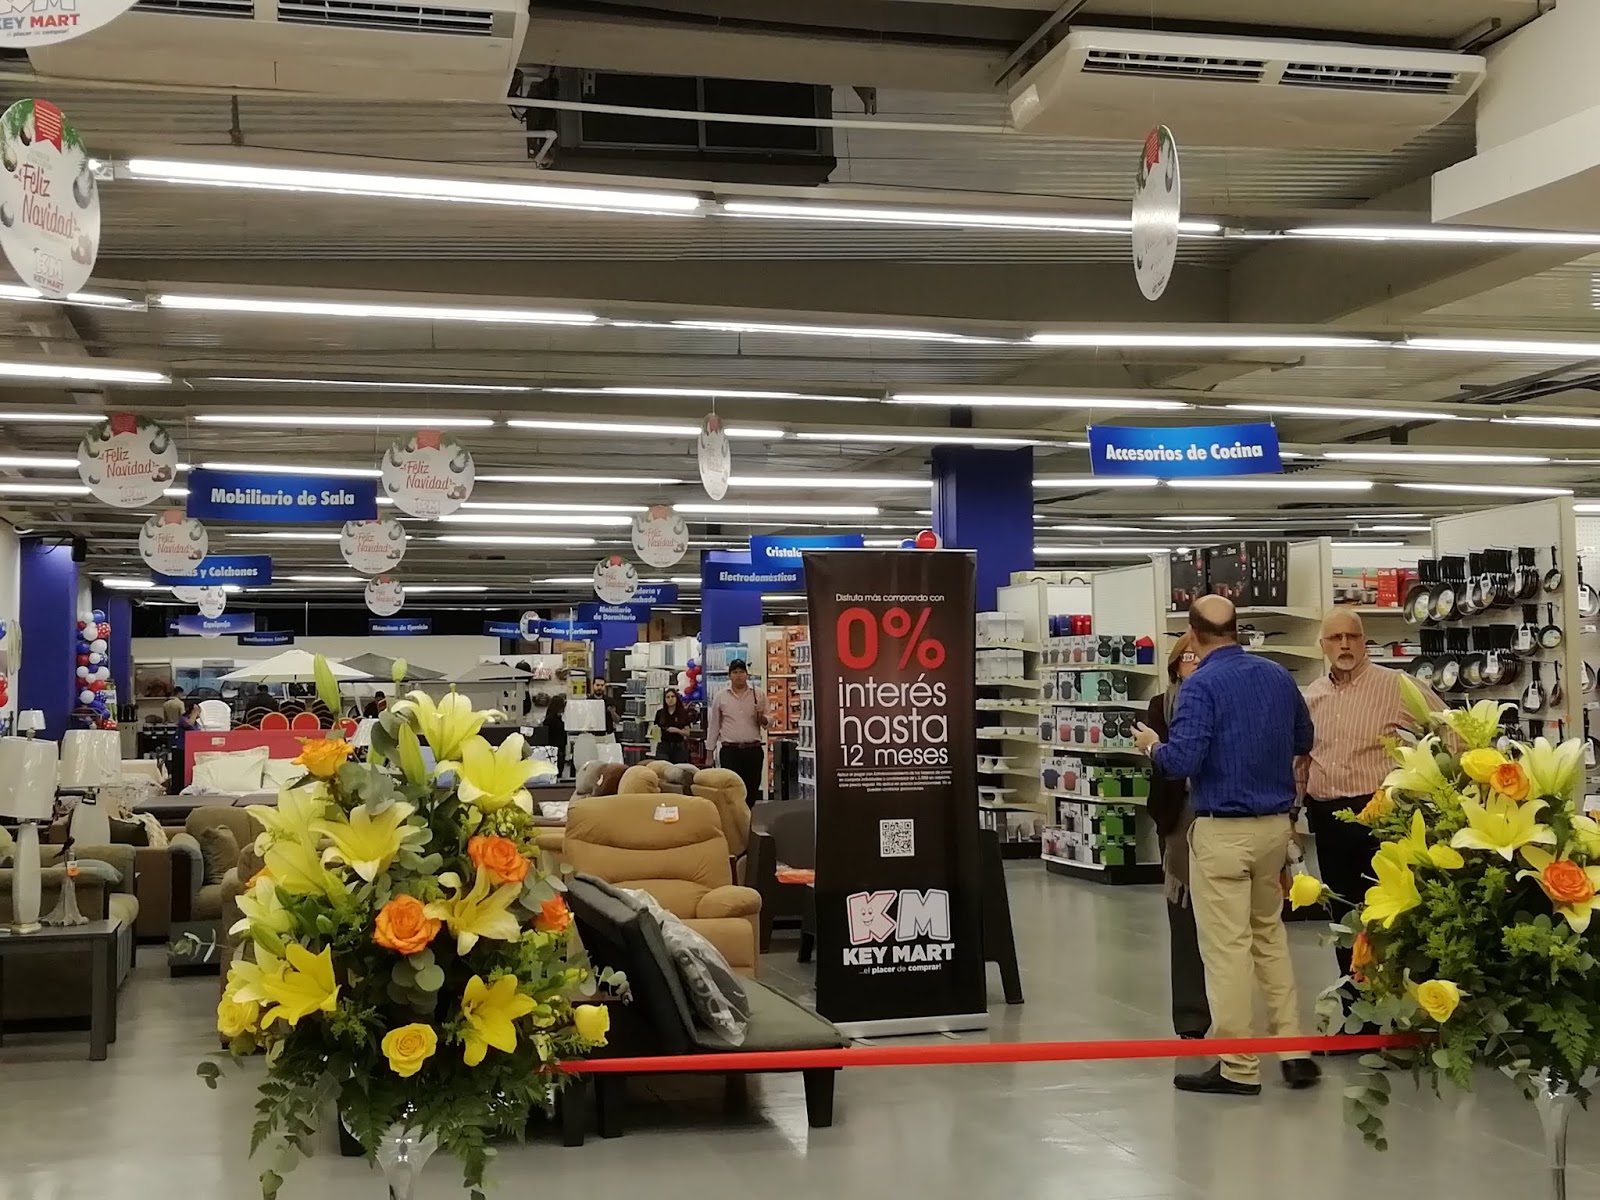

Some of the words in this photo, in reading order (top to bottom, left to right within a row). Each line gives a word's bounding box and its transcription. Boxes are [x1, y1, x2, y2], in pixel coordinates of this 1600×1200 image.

[30, 14, 80, 28] MART
[23, 163, 50, 197] Feliz
[22, 194, 73, 239] Navidad
[47, 279, 64, 290] MART
[105, 447, 129, 462] Feliz
[1106, 443, 1183, 461] Accesorios
[1186, 444, 1207, 460] de
[1210, 441, 1263, 459] Cocina
[107, 459, 152, 478] Navidad
[407, 460, 429, 474] Feliz
[406, 474, 449, 490] Navidad
[211, 488, 293, 506] Mobiliario
[297, 489, 317, 506] de
[320, 489, 354, 506] Sala
[158, 532, 174, 543] Feliz
[158, 543, 189, 554] Navidad
[358, 541, 388, 552] Navidad
[765, 546, 802, 558] Cristale
[200, 569, 207, 578] y
[208, 566, 258, 577] Colchones
[719, 571, 797, 582] Electrodomésticos
[836, 593, 864, 602] Disfruta
[864, 593, 882, 602] más
[882, 594, 928, 602] comprando
[407, 624, 428, 632] Ejercicio
[836, 607, 946, 670] 0%
[838, 673, 947, 708] interés
[840, 707, 948, 744] hasta
[840, 744, 864, 766] 12
[874, 748, 948, 766] meses
[846, 888, 950, 946] KM
[843, 946, 888, 966] KEY
[892, 943, 955, 963] MART
[872, 966, 896, 975] placer
